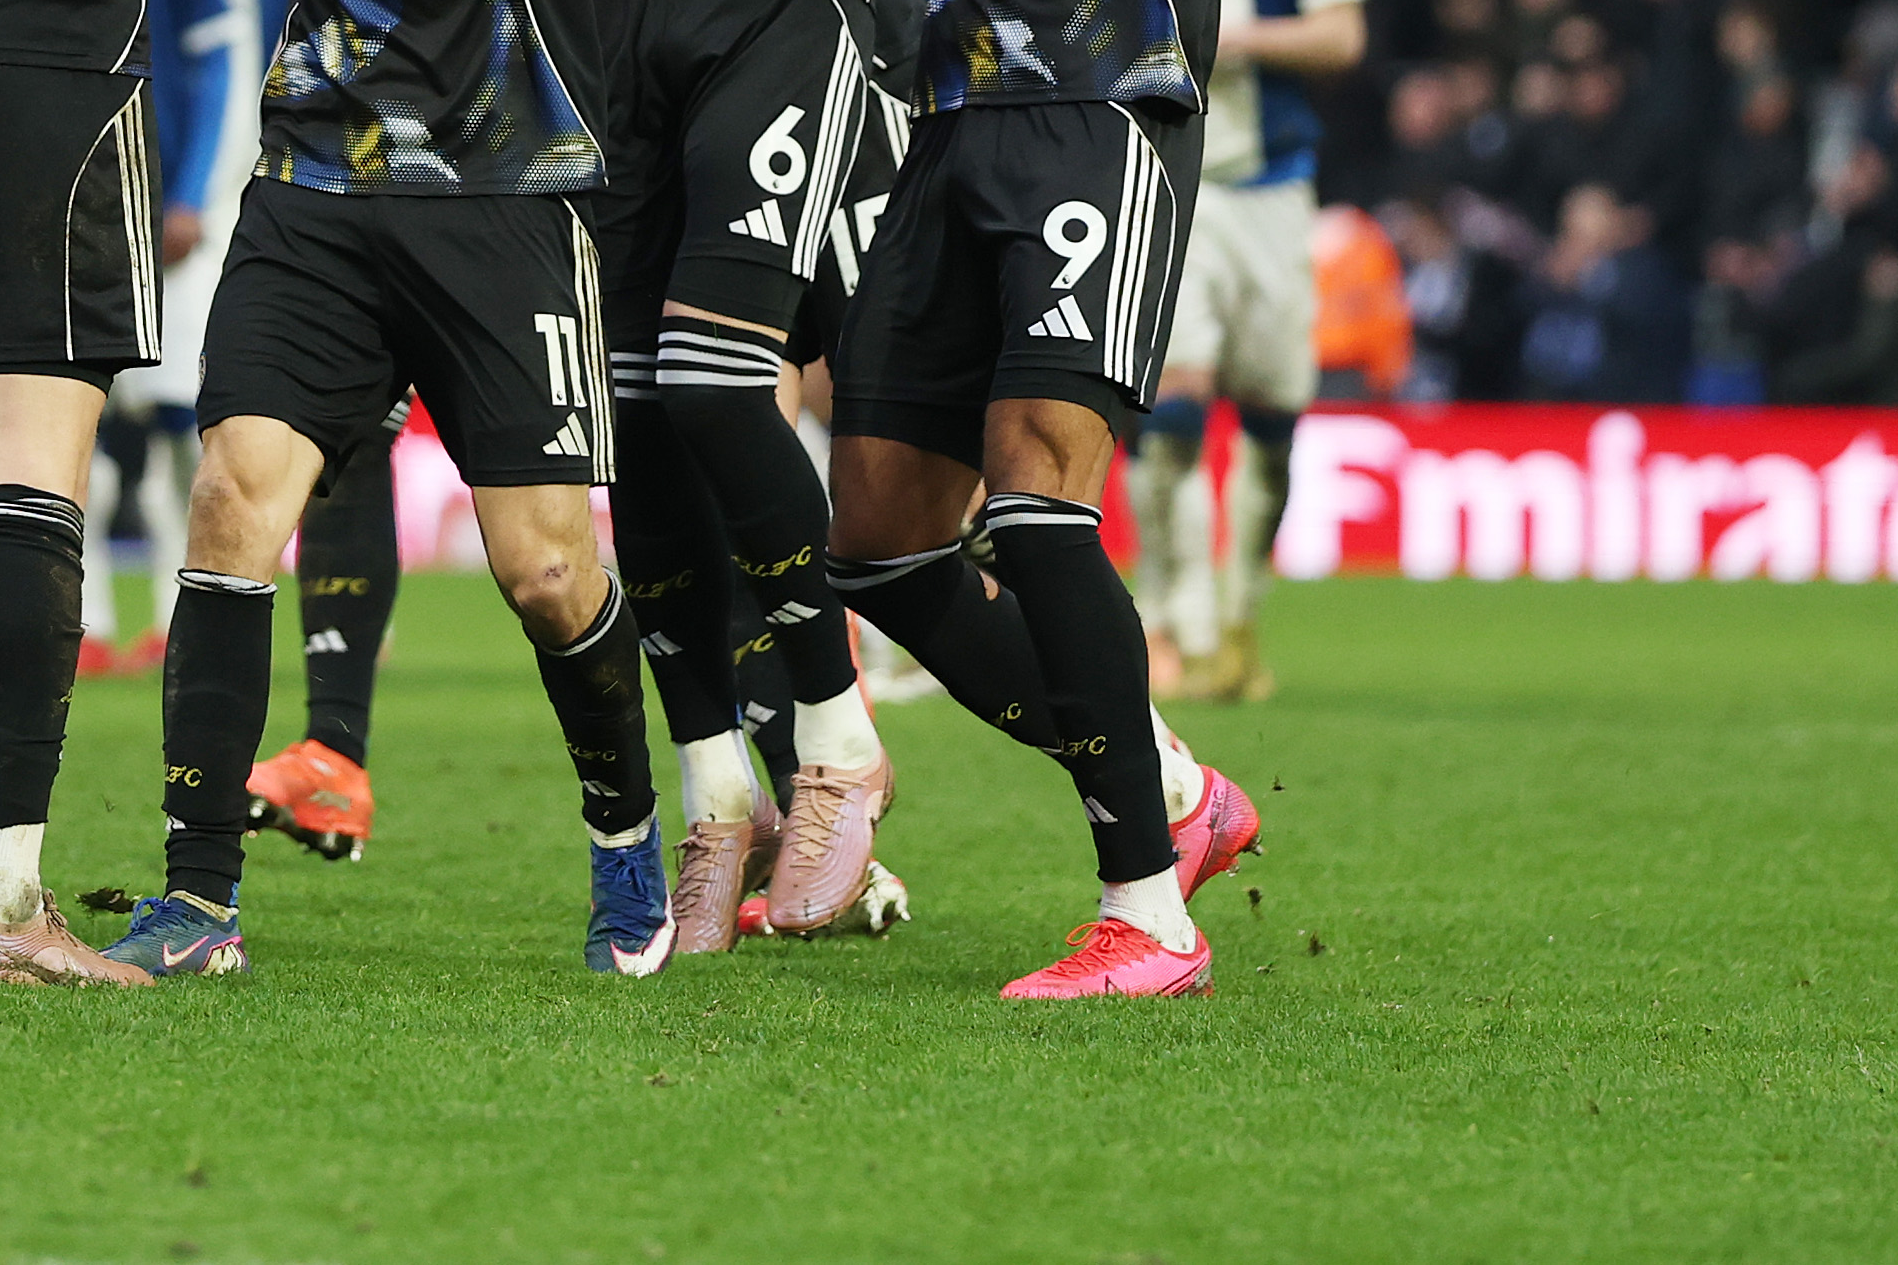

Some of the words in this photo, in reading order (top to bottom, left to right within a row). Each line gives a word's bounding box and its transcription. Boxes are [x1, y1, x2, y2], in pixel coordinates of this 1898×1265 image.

[749, 104, 807, 195] 6
[1042, 200, 1108, 290] 9
[534, 313, 588, 407] 11
